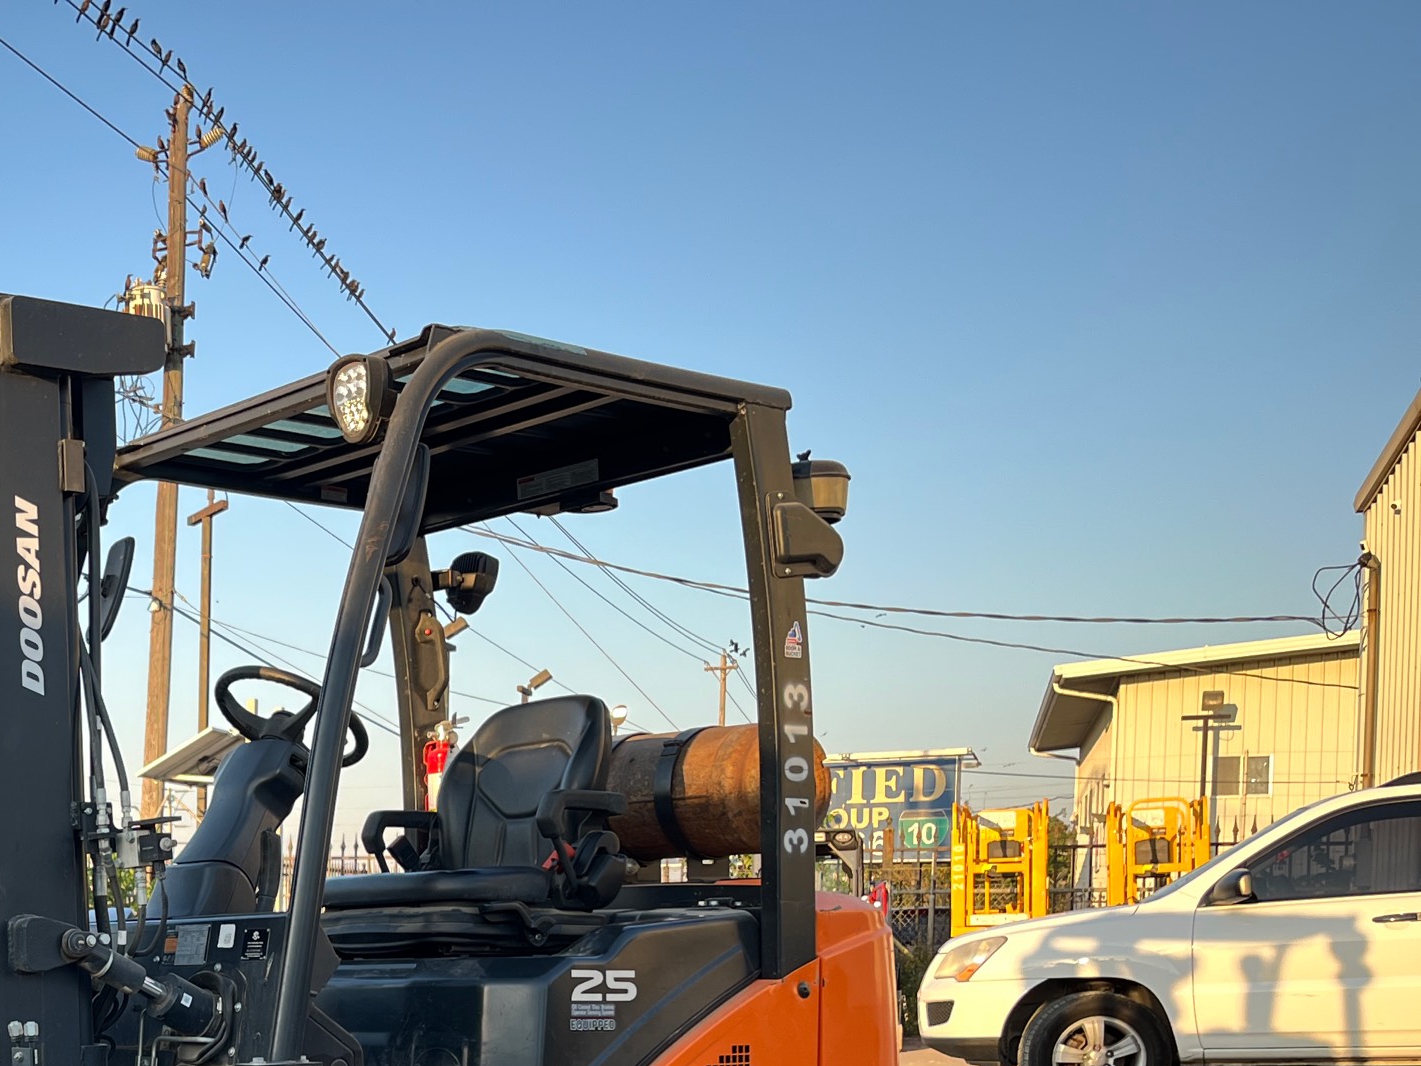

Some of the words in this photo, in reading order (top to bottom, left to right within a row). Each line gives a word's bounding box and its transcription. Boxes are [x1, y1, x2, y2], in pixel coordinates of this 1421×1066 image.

[14, 495, 45, 696] DOOSAN
[784, 684, 809, 853] 31013
[908, 823, 937, 845] 10
[952, 845, 966, 891] 21010
[571, 969, 638, 1002] 25
[570, 1019, 616, 1031] EQUIPPED
